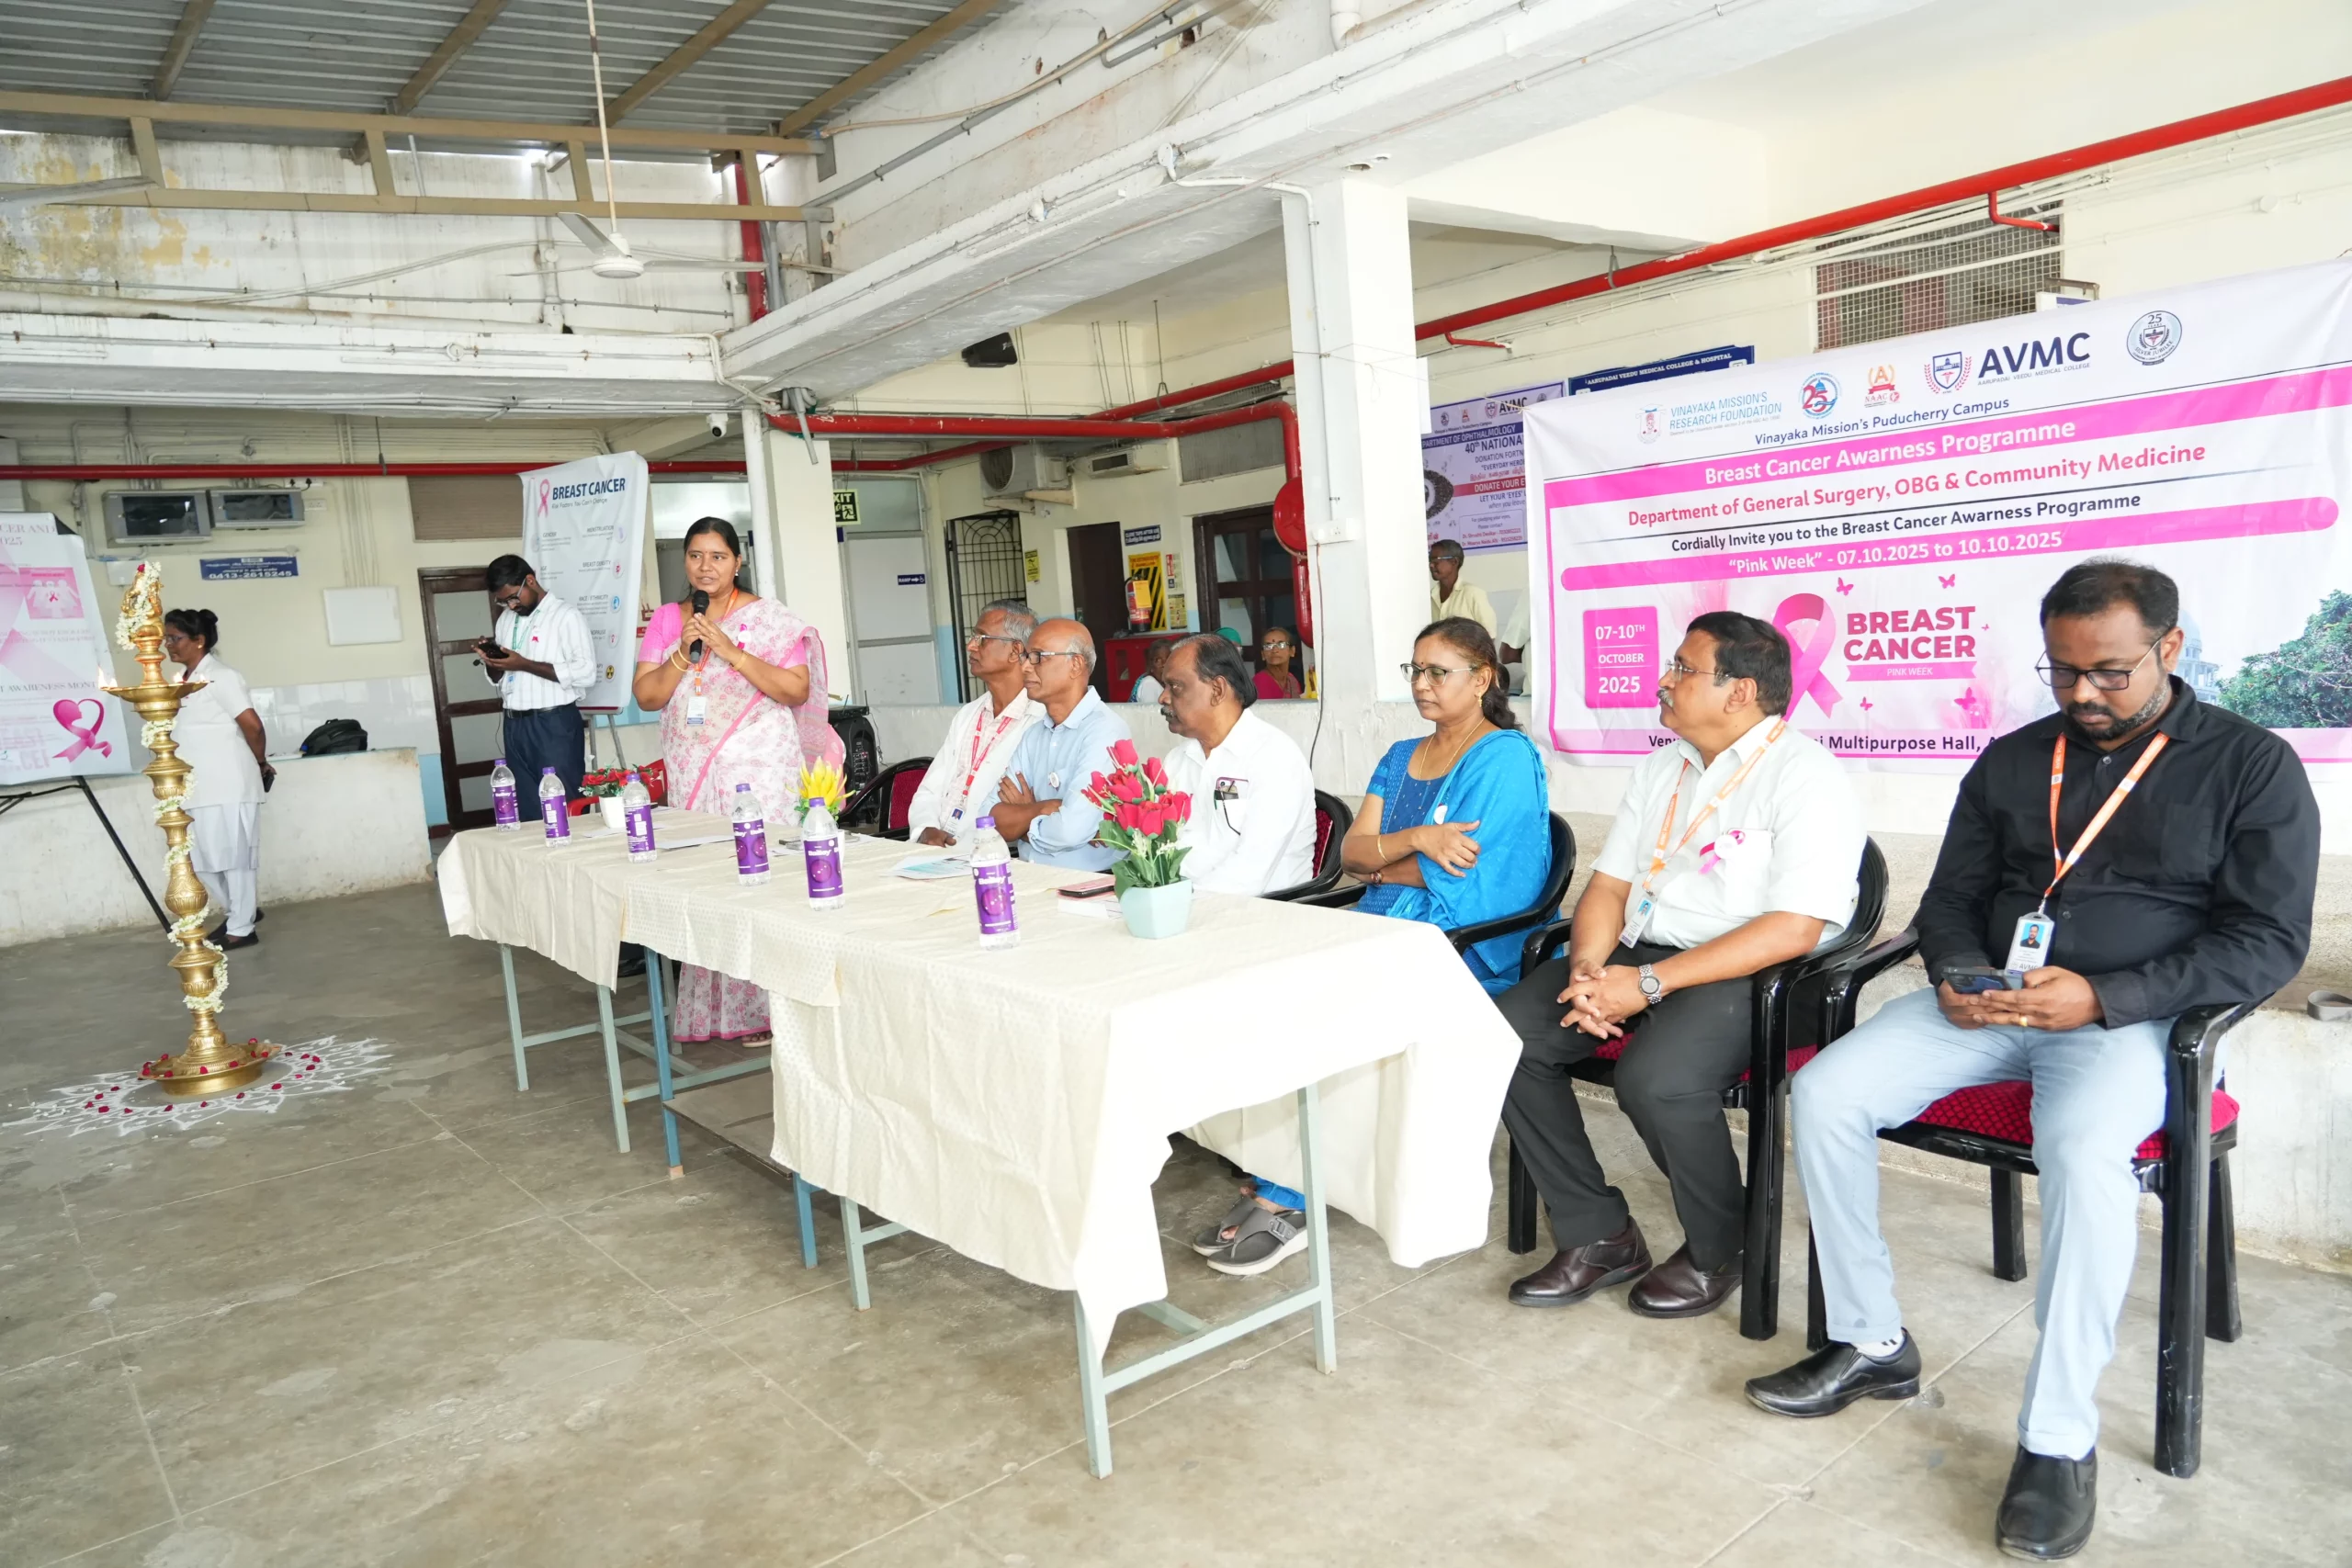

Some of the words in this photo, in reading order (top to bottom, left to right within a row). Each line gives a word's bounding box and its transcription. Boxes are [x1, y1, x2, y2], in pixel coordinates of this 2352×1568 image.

[2147, 313, 2163, 324] 25
[1978, 332, 2091, 378] AVMC
[2134, 346, 2151, 356] SILVER
[2153, 340, 2174, 356] JUBILEE
[1588, 375, 1618, 385] AARUPADAI
[1619, 370, 1638, 378] VEEDU
[1639, 366, 1665, 376] MEDICAL
[1666, 360, 1693, 370] COLLEGE
[1701, 353, 1732, 364] HOSPITAL
[1978, 377, 2010, 386] AARUPADAI
[2035, 367, 2061, 377] MEDICAL
[2064, 362, 2090, 372] COLLEGE
[1670, 400, 1716, 417] VINAYAKA
[1718, 391, 1768, 410] MISSION'S
[1803, 385, 1828, 412] 25
[1864, 393, 1887, 402] NAAC
[1669, 413, 1718, 430] RESEARCH
[1720, 402, 1782, 423] FOUNDATION
[1755, 429, 1808, 446] Vinayaka
[1873, 407, 1949, 428] Puducherry
[1952, 399, 2009, 417] Campus
[1461, 424, 1516, 442] OPHTHALMOLOGY
[1465, 441, 1481, 454] 40th
[1705, 462, 1761, 485] Breast
[1766, 455, 1831, 477] Cancer
[1836, 441, 1936, 468] Awarness
[1942, 422, 2075, 454] Programme
[1475, 453, 1504, 463] DONATION
[552, 483, 588, 500] BREAST
[588, 478, 626, 496] CANCER
[1475, 481, 1500, 492] DONATE
[1501, 479, 1520, 490] YOUR
[1628, 502, 1718, 528] Department
[1722, 498, 1739, 515] of
[1743, 490, 1809, 513] General
[1814, 484, 1891, 506] Surgery,
[1894, 474, 1939, 496] OBG
[1944, 472, 1960, 490] &
[1964, 458, 2092, 488] Community
[2098, 445, 2206, 473] Medicine
[833, 492, 853, 503] XIT
[1480, 493, 1488, 502] LET
[1489, 491, 1506, 501] YOUR
[586, 525, 614, 534] MENSTRUATION
[1671, 535, 1725, 551] Cordially
[1728, 531, 1766, 547] Invite
[1769, 532, 1793, 546] you
[1796, 527, 1811, 540] to
[1815, 524, 1838, 538] the
[1842, 519, 1890, 536] Breast
[1894, 515, 1948, 531] Cancer
[1951, 506, 2032, 525] Awarness
[2037, 495, 2141, 517] Programme
[1838, 542, 1929, 565] 07.10.2025
[1934, 542, 1953, 557] to
[1958, 531, 2063, 556] 10.10.2025
[1847, 605, 1976, 636] BREAST
[1595, 625, 1645, 640] 07-10TH
[1843, 635, 1976, 661] CANCER
[1598, 653, 1645, 664] OCTOBER
[1886, 668, 1907, 677] PINK
[1908, 667, 1933, 676] WEEK
[8, 682, 65, 692] AWARENESS
[1598, 676, 1641, 694] 2025
[1828, 736, 1937, 752] Multipurpose
[1942, 737, 1981, 752] Hall,
